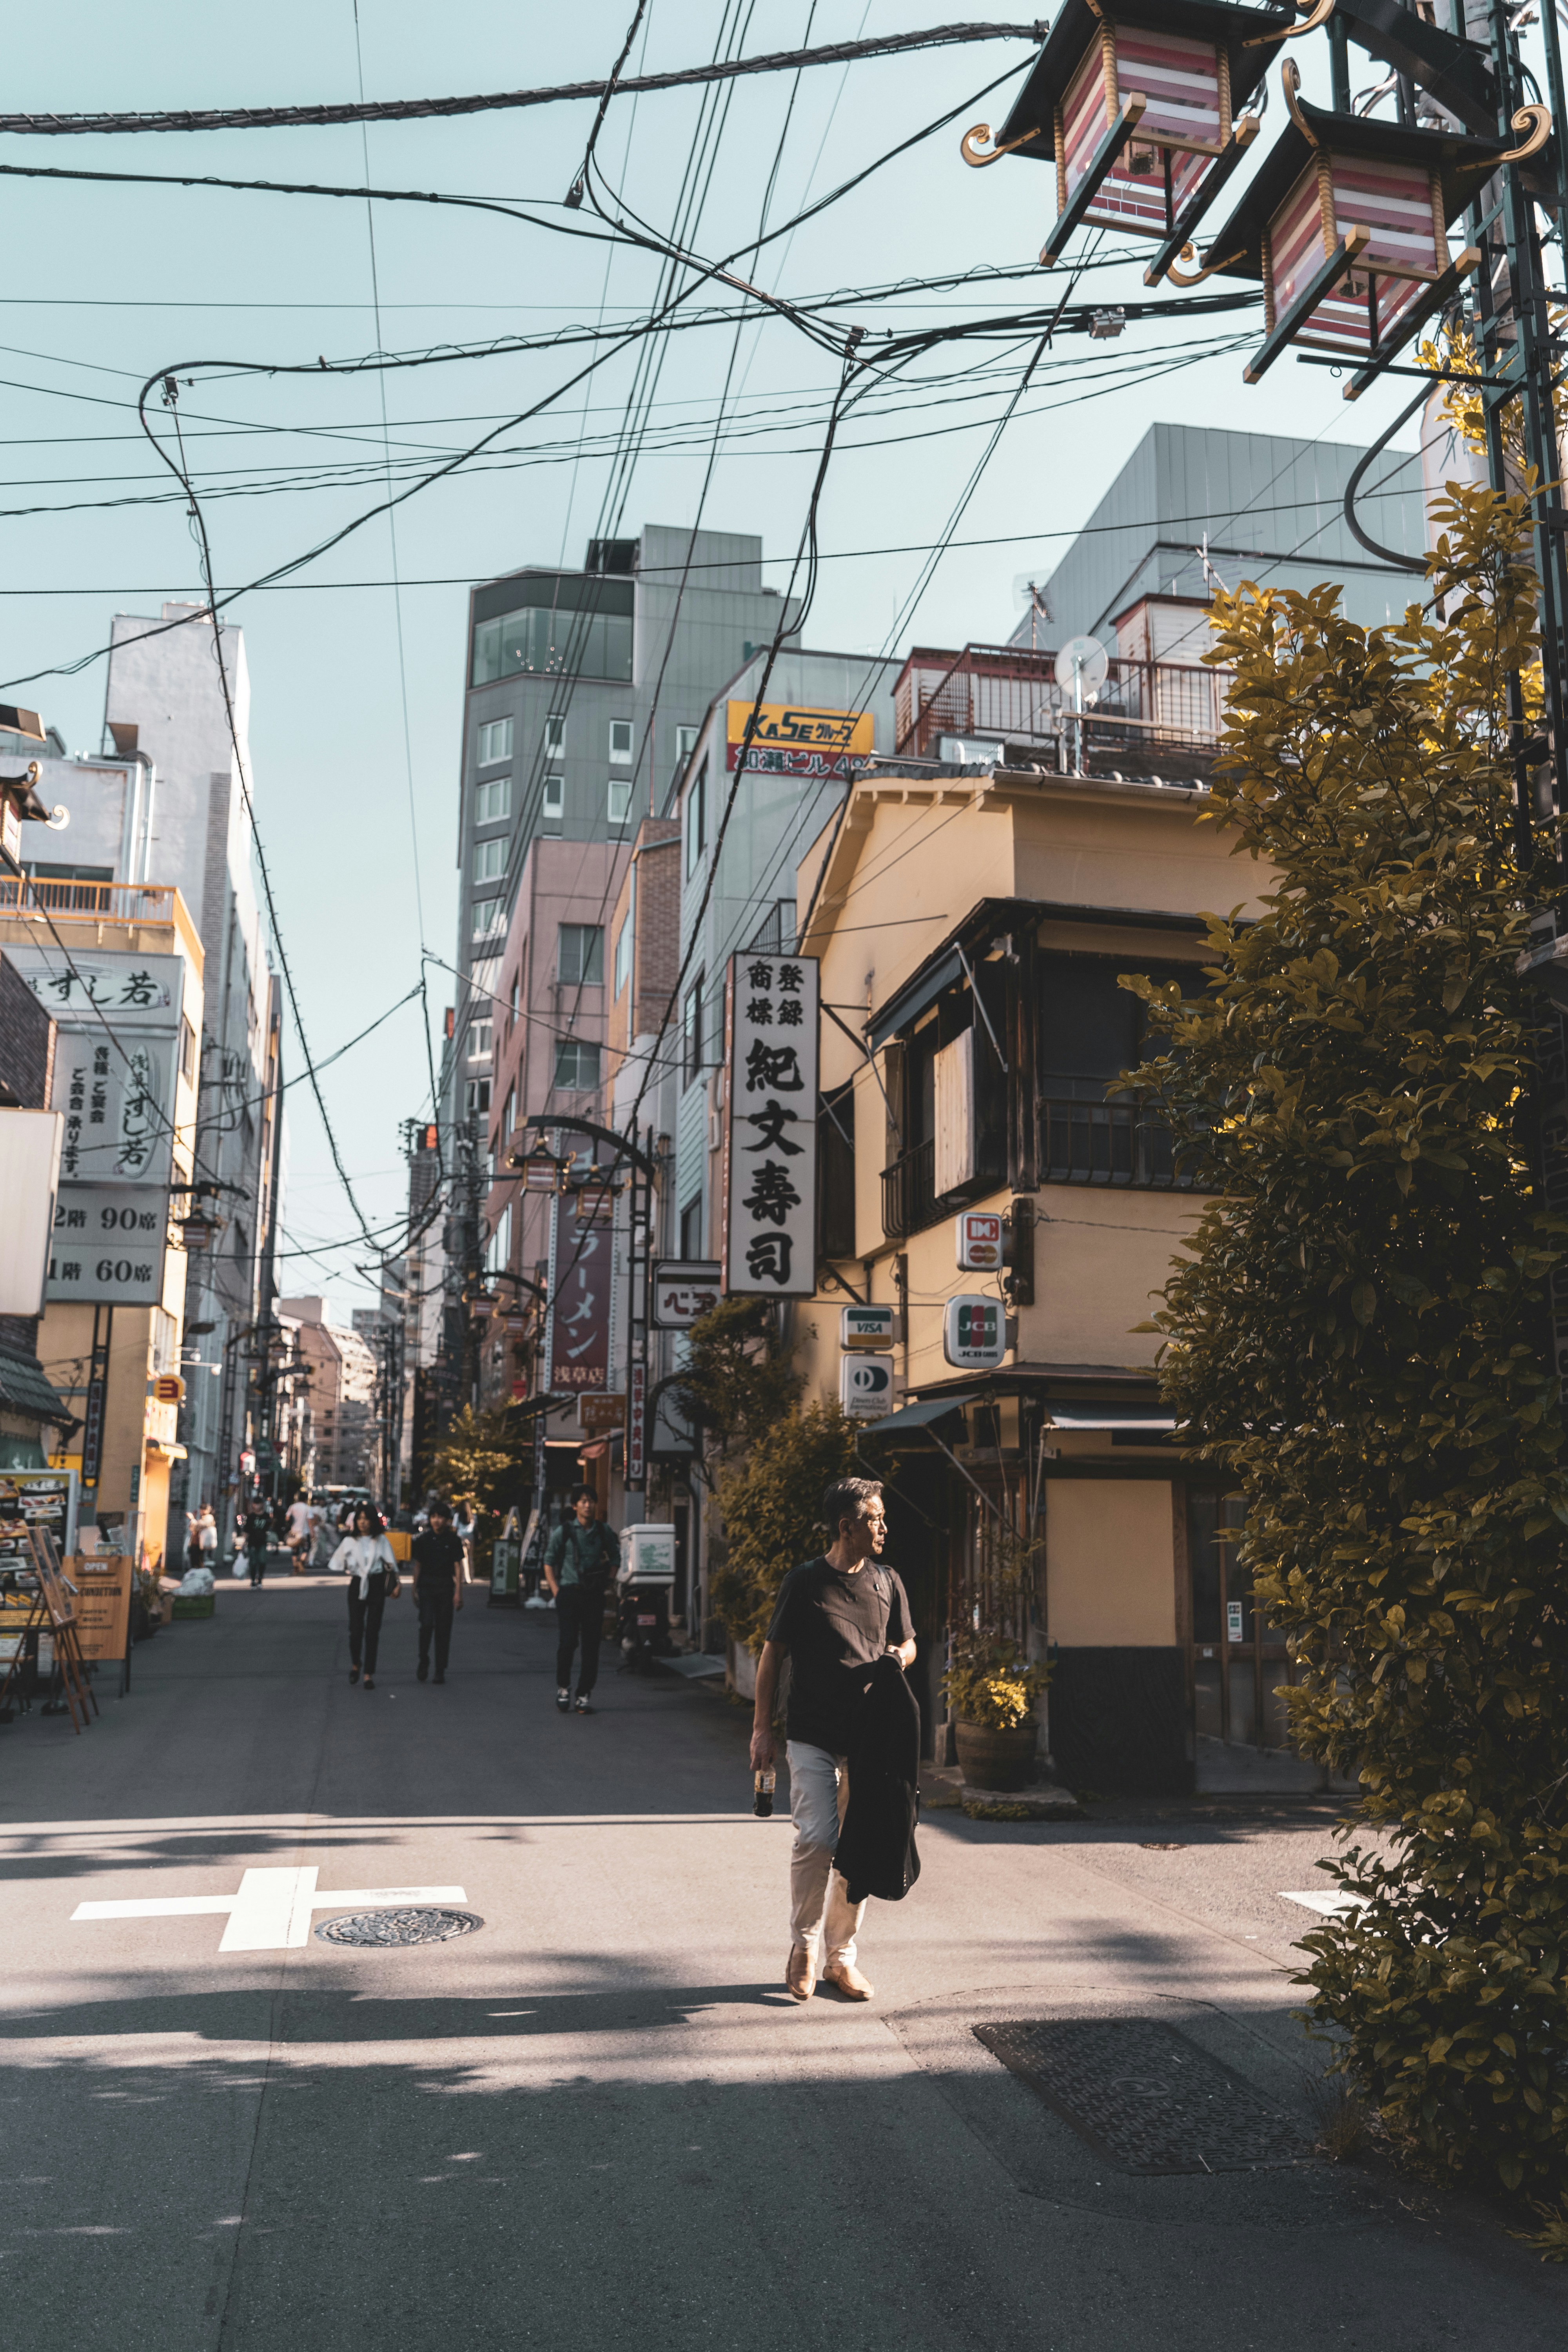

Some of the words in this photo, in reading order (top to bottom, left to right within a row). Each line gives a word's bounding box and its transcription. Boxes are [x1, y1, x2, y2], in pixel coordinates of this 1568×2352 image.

[101, 1207, 158, 1230] 90席
[96, 1259, 153, 1283] 60席
[857, 1323, 882, 1333] VISA
[959, 1321, 996, 1332] JCB
[554, 1365, 605, 1384] 浅草店
